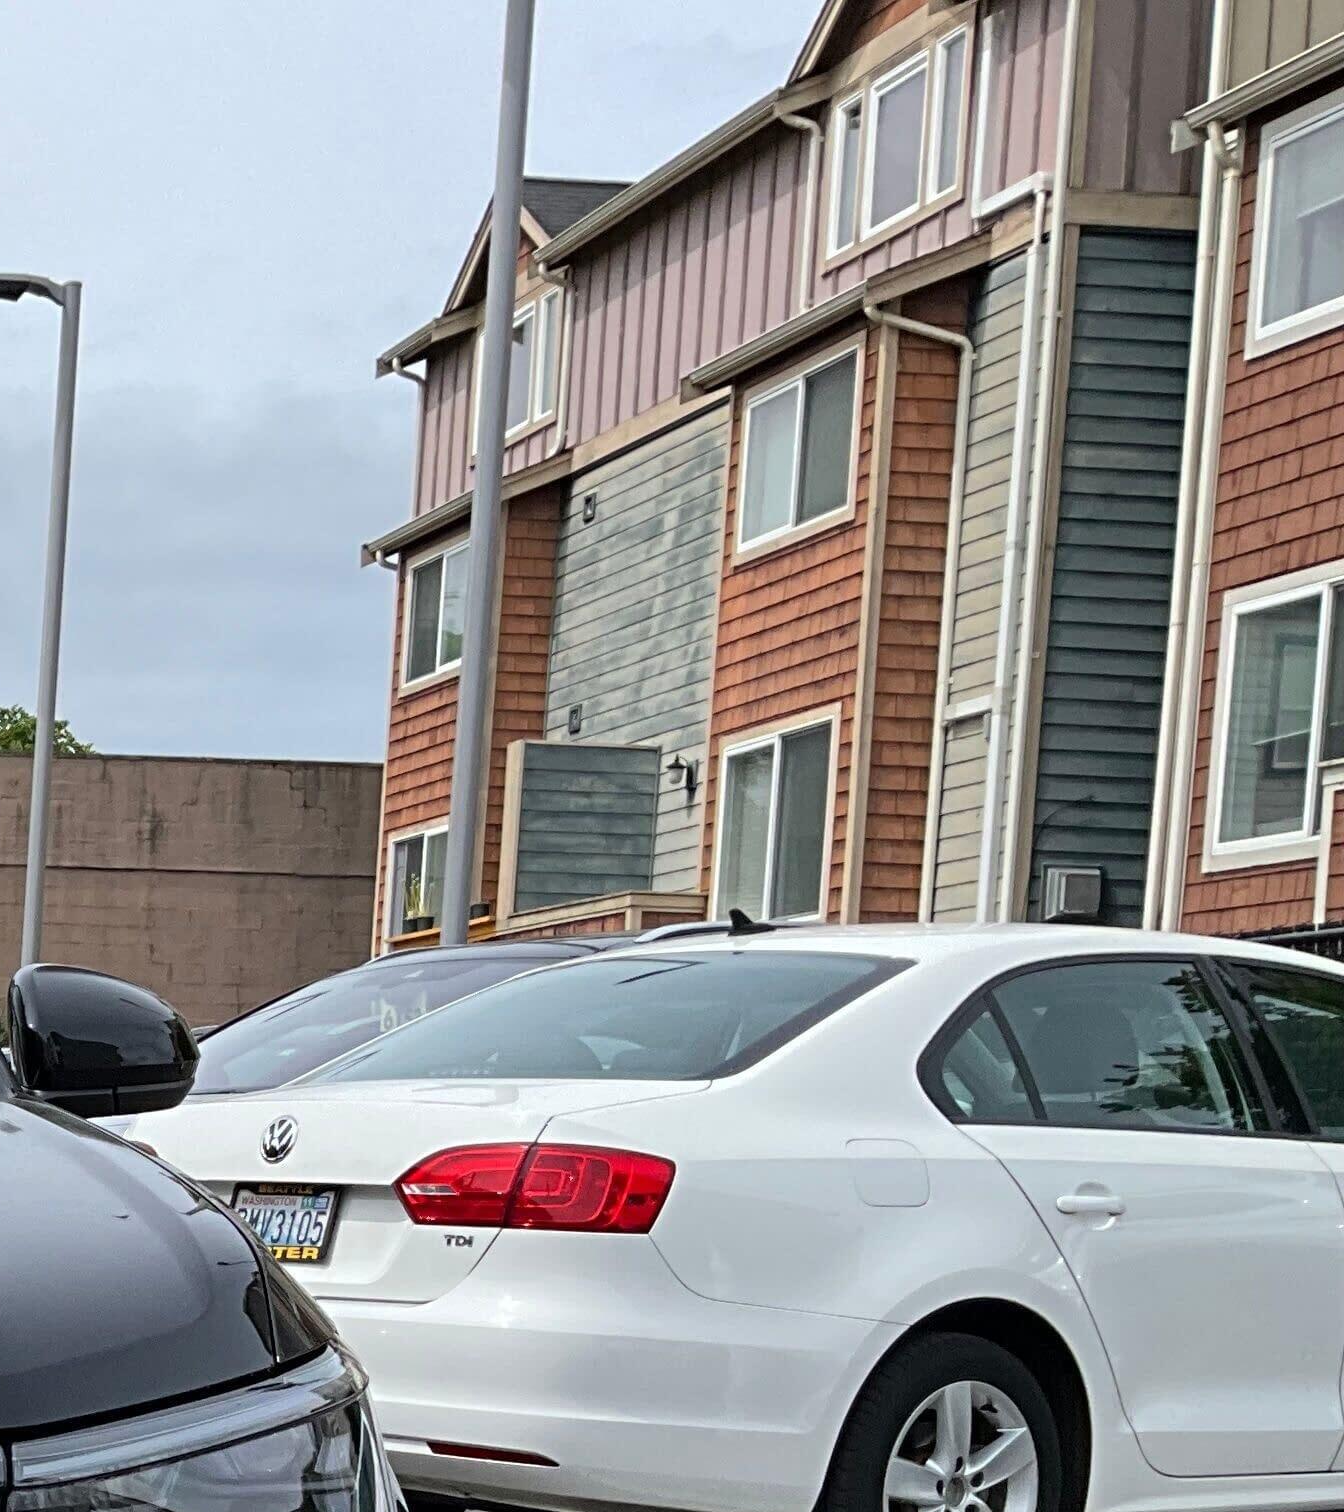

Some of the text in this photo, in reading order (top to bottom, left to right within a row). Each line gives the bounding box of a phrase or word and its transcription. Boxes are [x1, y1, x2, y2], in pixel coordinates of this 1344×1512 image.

[258, 1184, 313, 1194] SEATTLE
[241, 1196, 298, 1207] WASHINGTON
[444, 1234, 474, 1248] TDI
[269, 1246, 320, 1260] TER
